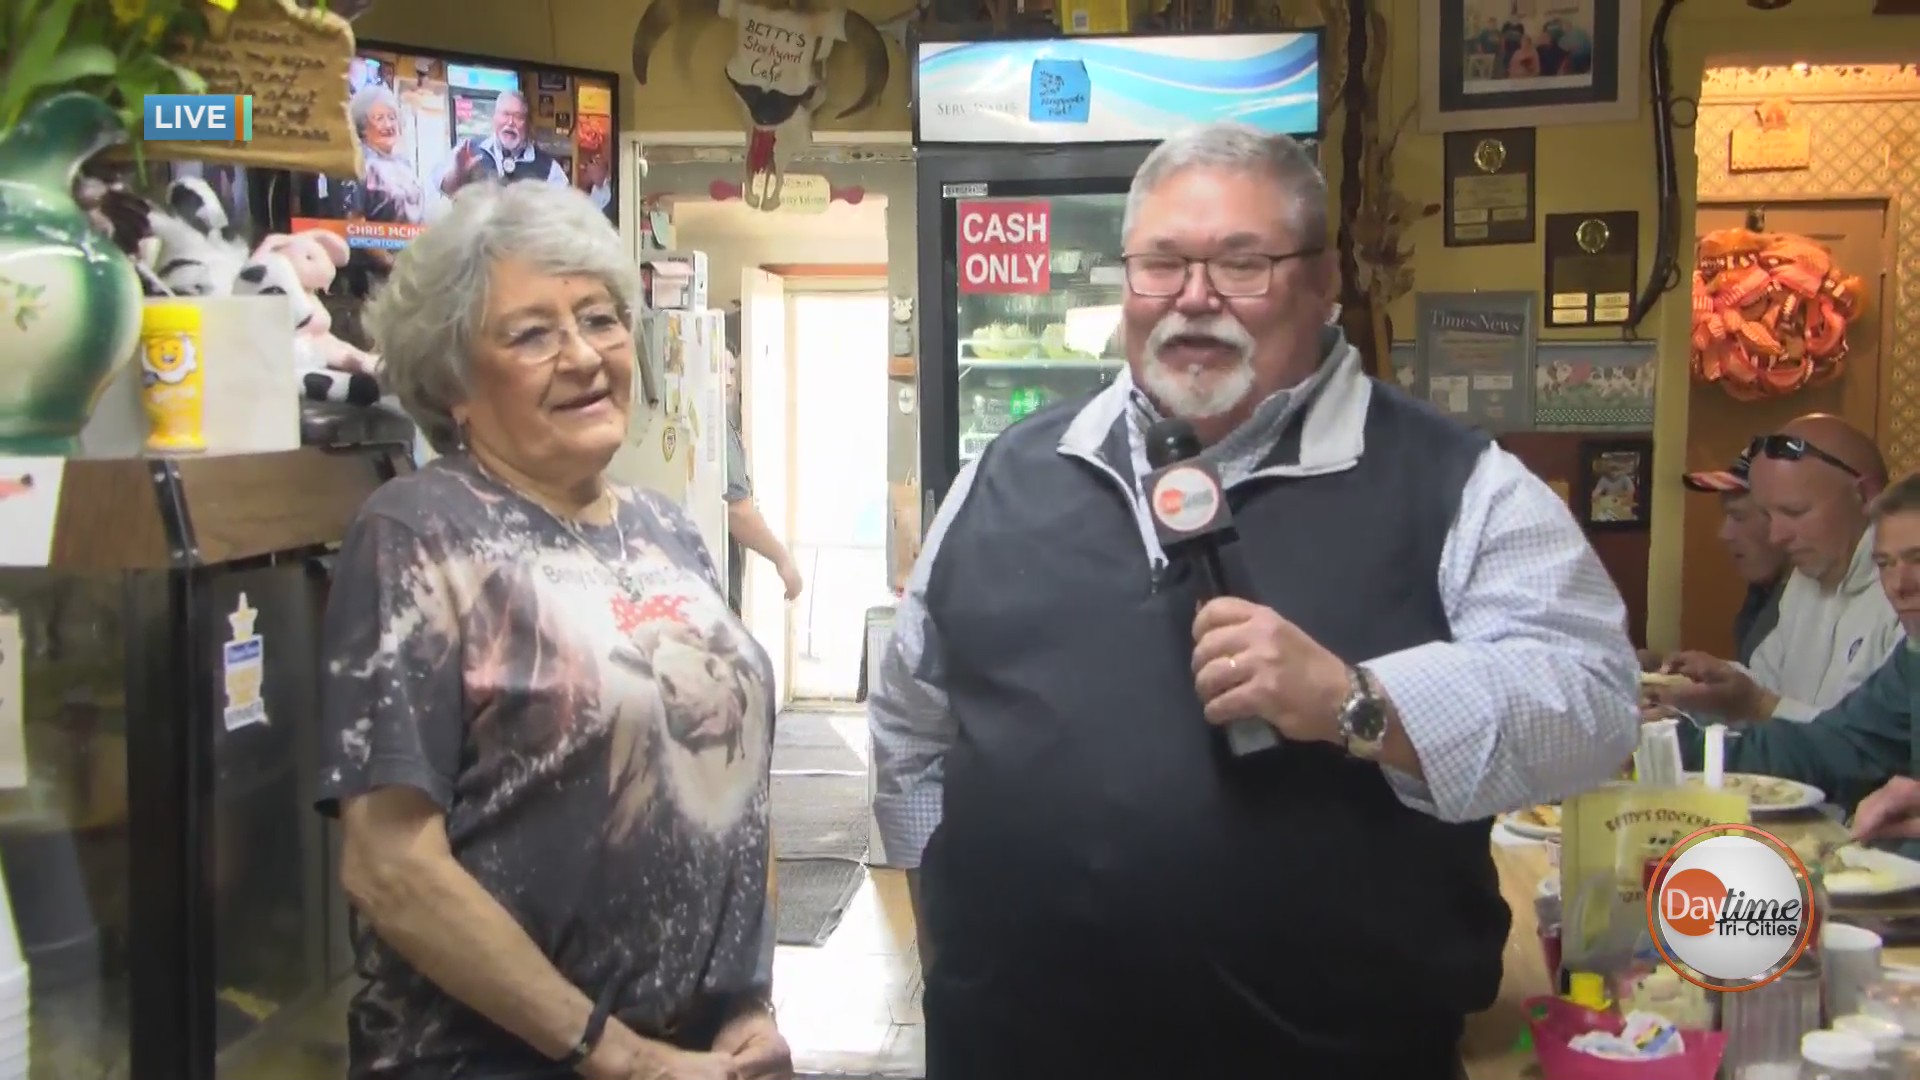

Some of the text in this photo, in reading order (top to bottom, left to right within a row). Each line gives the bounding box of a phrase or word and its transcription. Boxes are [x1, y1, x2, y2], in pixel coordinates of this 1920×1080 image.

[746, 19, 806, 48] BETTY'S
[347, 224, 385, 236] CHRIS
[963, 212, 1047, 243] CASH
[965, 253, 1046, 284] ONLY
[1430, 309, 1521, 333] Times News
